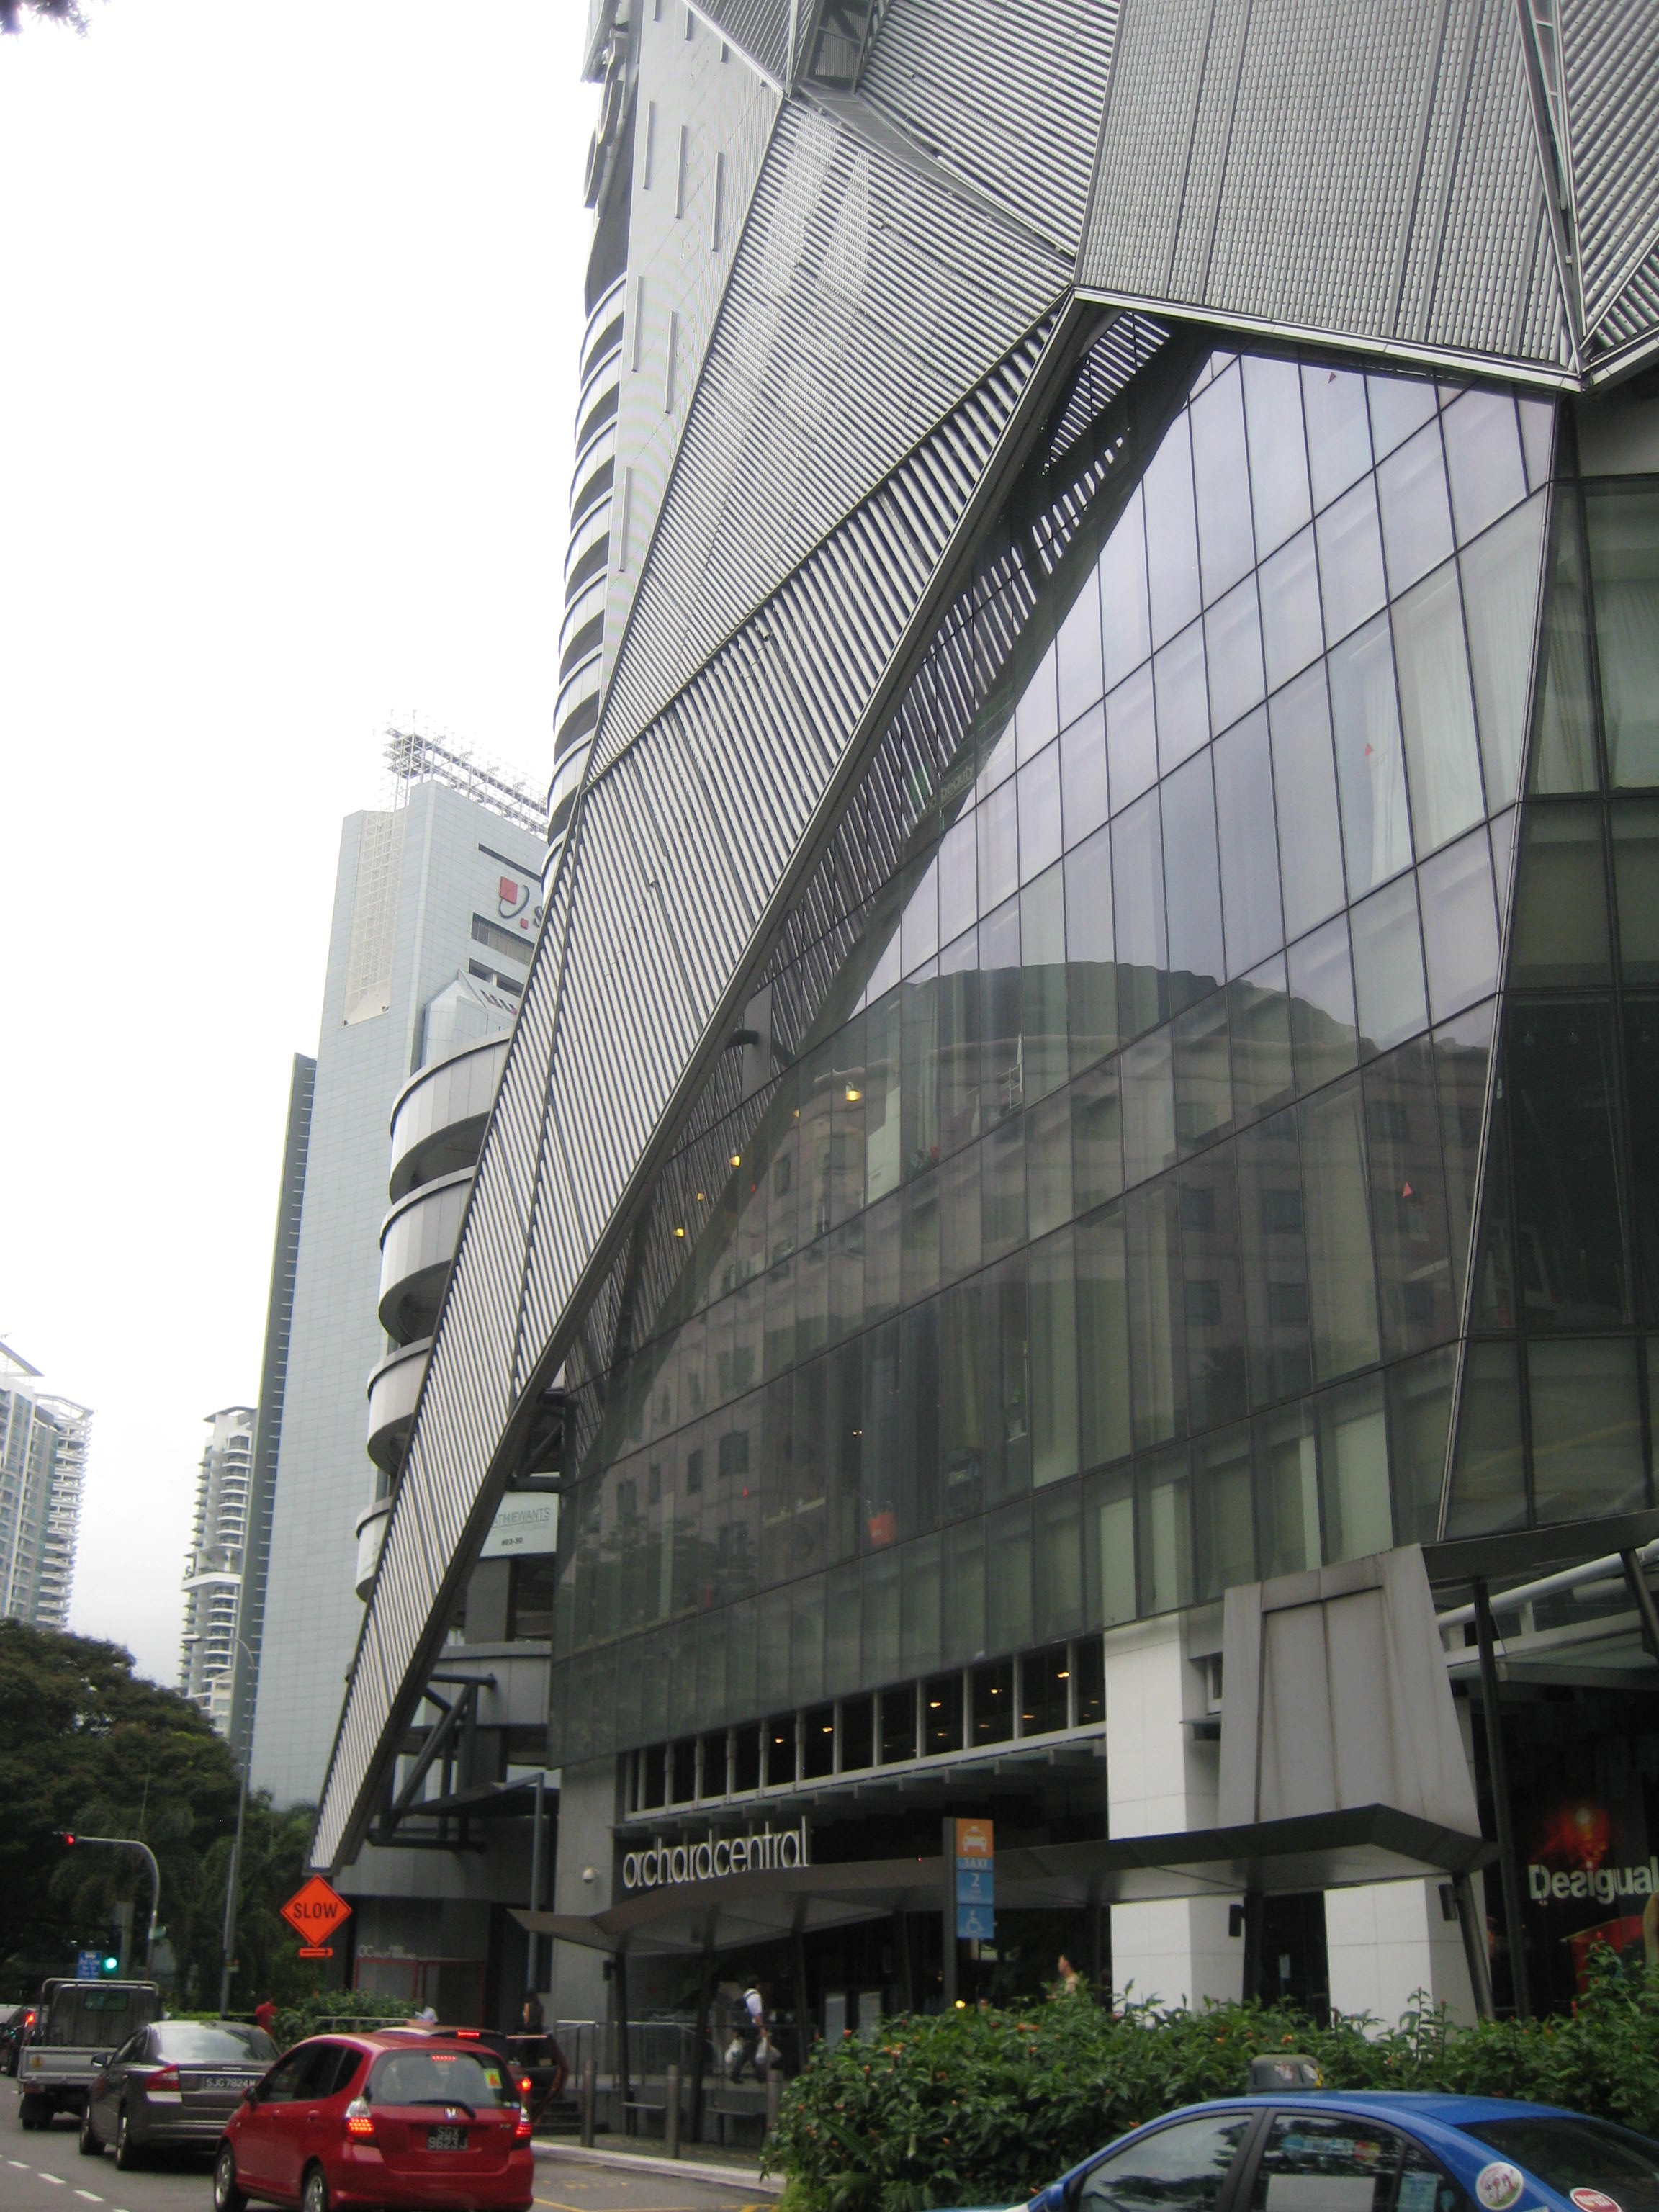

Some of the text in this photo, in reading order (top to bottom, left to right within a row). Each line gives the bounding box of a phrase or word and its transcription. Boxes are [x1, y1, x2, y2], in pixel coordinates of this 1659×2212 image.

[623, 1815, 809, 1888] orchardcentral
[964, 1858, 987, 1868] TAXI
[971, 1873, 980, 1887] 2
[1528, 1856, 1659, 1905] Desigual
[293, 1902, 338, 1918] SLOW
[428, 2136, 468, 2149] 9623J
